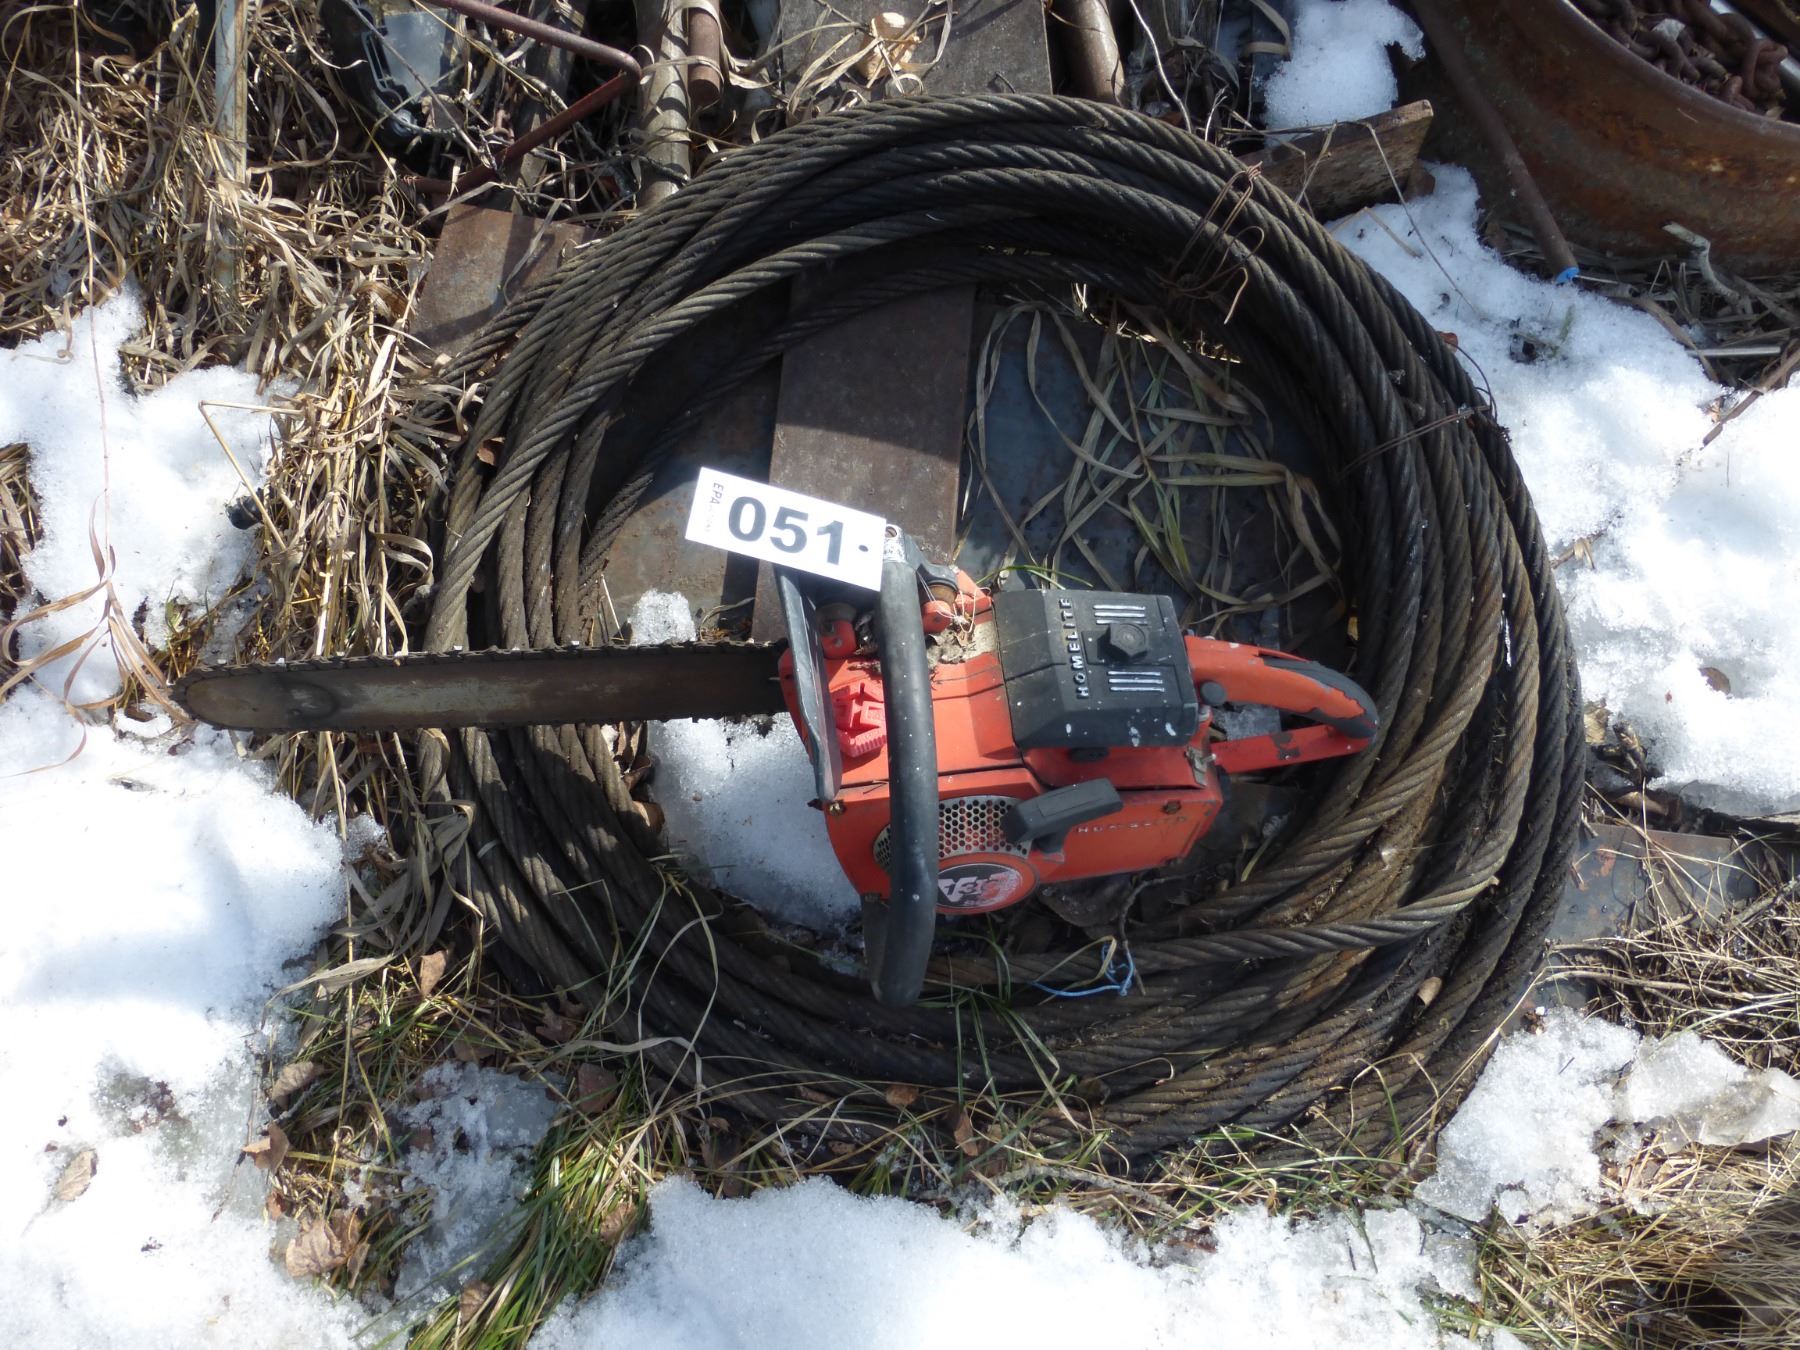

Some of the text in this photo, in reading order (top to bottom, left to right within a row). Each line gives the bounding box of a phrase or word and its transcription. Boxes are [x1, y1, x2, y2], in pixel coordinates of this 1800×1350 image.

[709, 481, 725, 505] EPA
[728, 496, 844, 566] 051
[1059, 598, 1089, 700] HOMELITE
